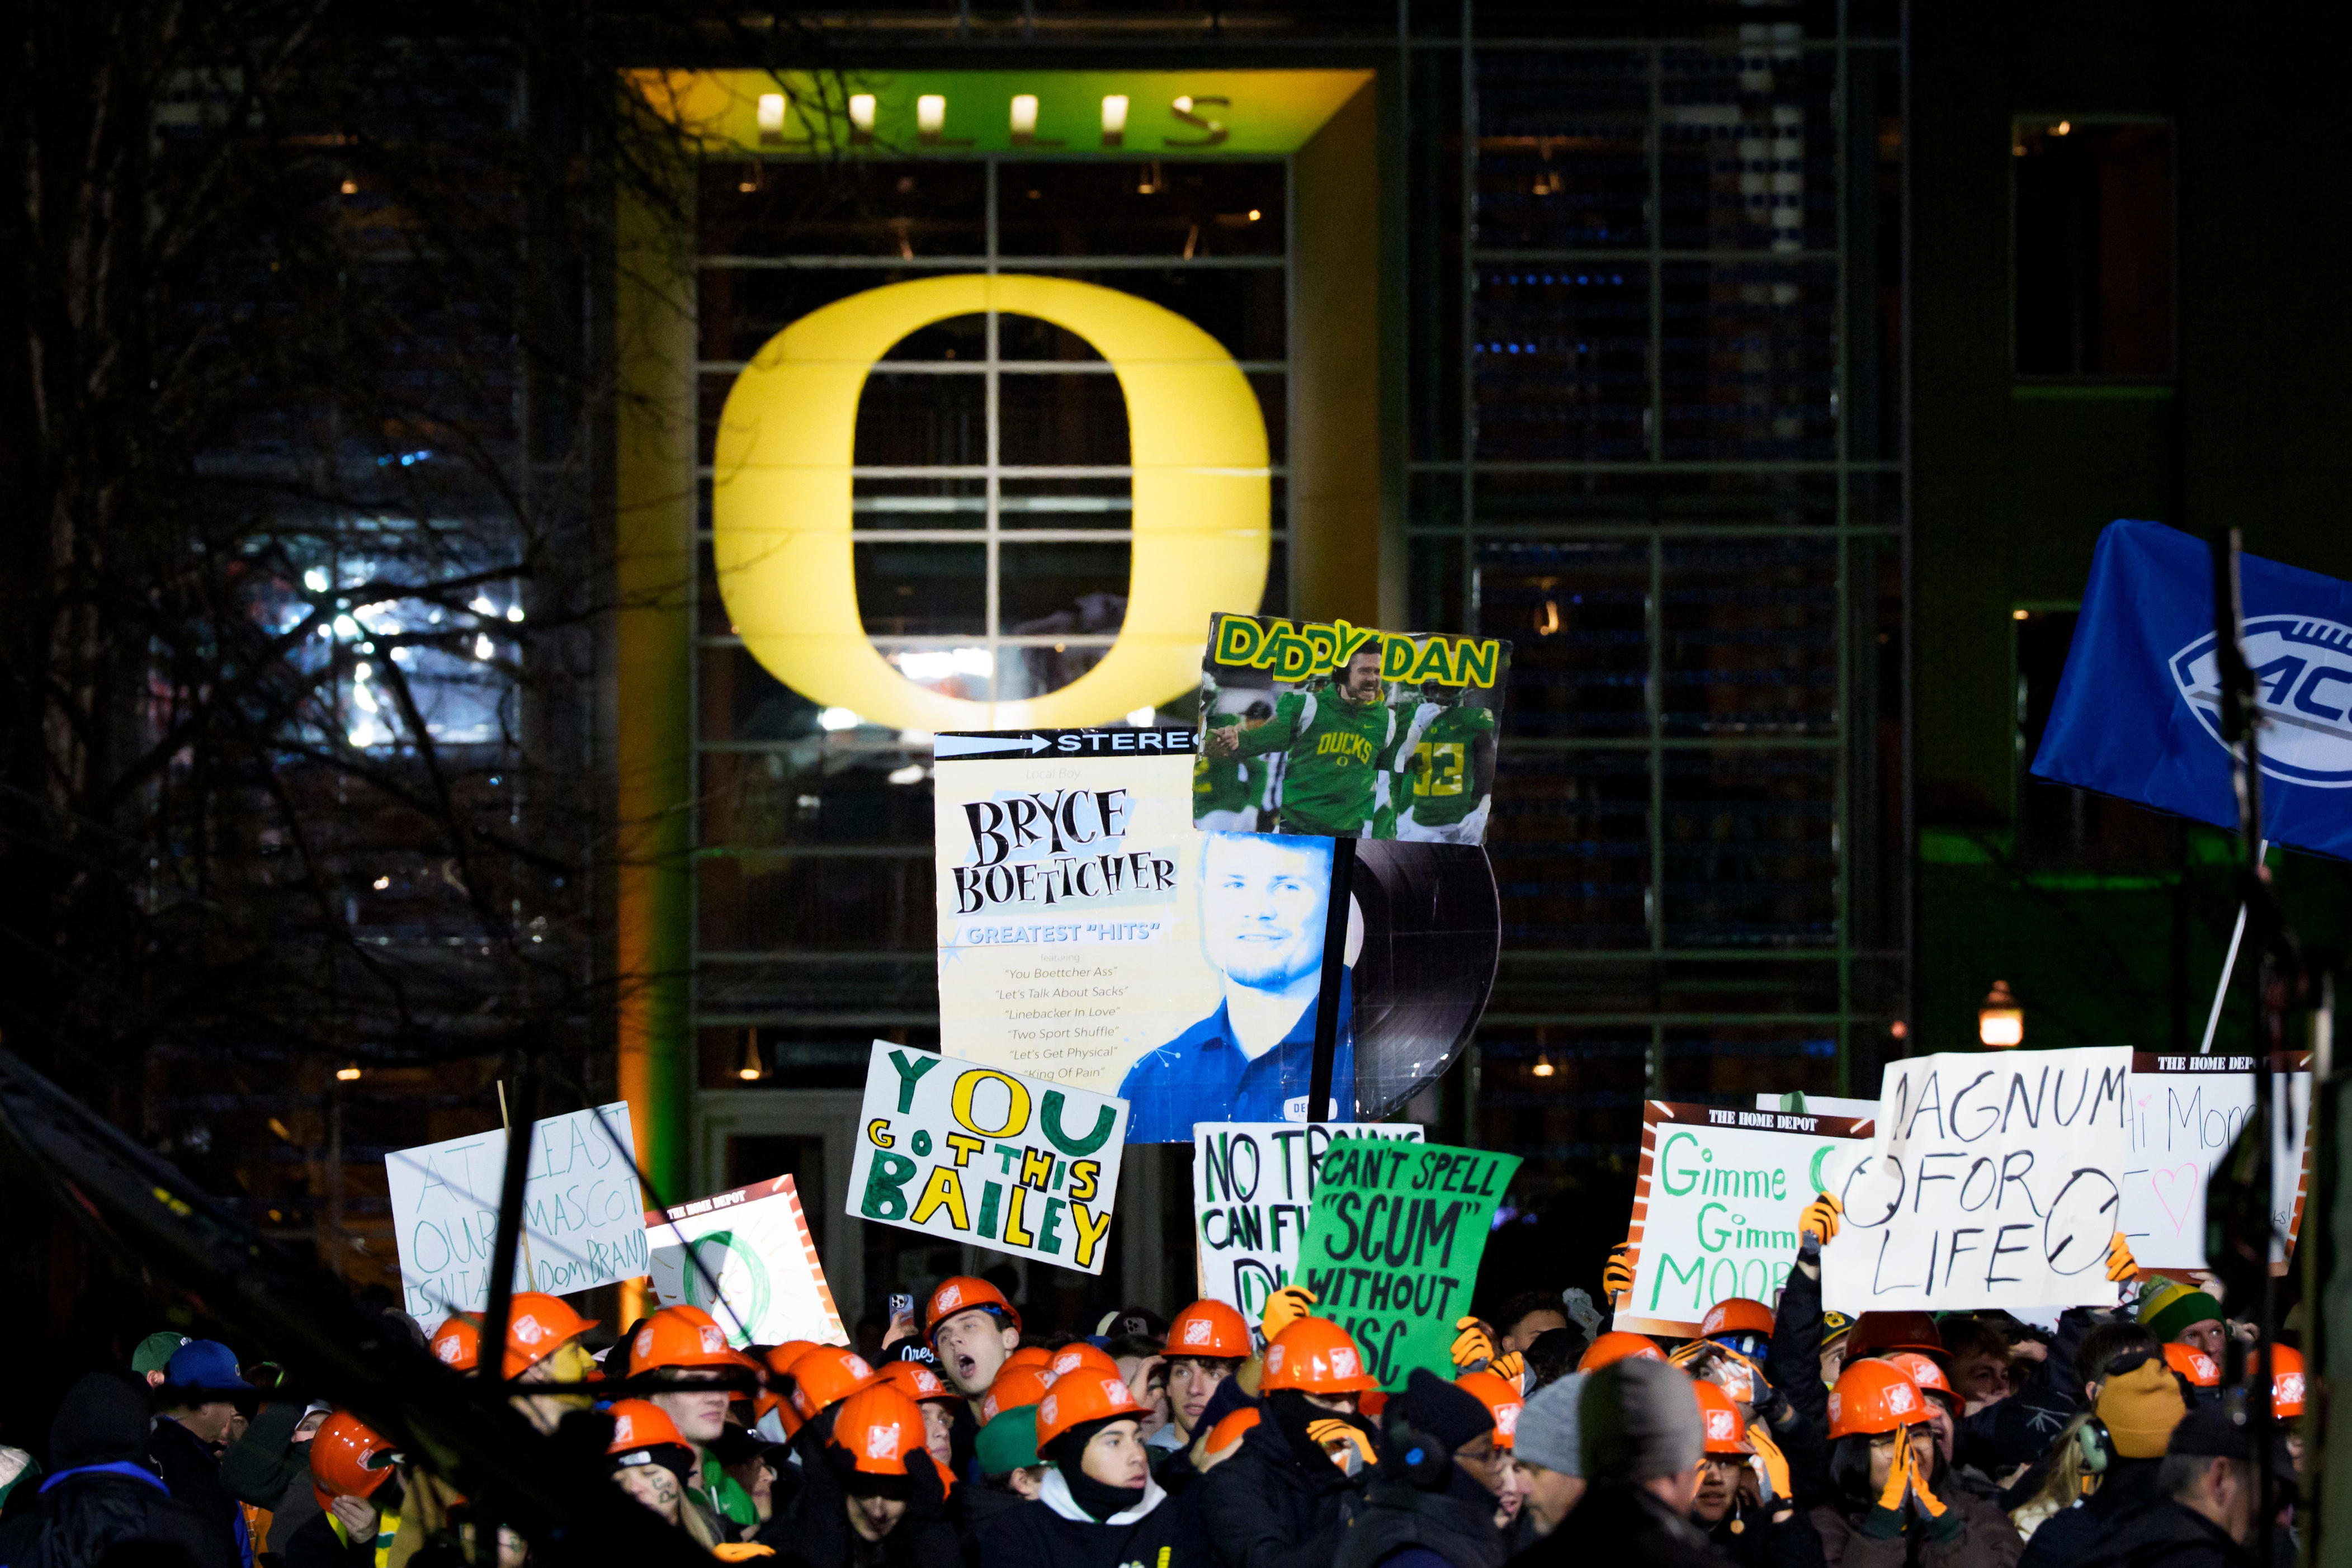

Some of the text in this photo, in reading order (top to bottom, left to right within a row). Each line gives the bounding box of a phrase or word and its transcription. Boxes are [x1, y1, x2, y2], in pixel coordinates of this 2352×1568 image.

[712, 273, 1271, 730] O
[1380, 637, 1499, 688] DAN
[2213, 654, 2352, 724] AC
[1057, 732, 1198, 751] STERE
[1317, 733, 1372, 765] DUCKS
[1026, 768, 1081, 781] Local Boy
[962, 788, 1127, 868] BRYCE
[952, 852, 1177, 914] BOETTCHER
[967, 923, 1160, 943] GREATEST "HITS"
[1041, 953, 1079, 963] featuring
[995, 986, 1128, 1000] "Let's Talk About Sacks"
[1005, 966, 1117, 979] "You Boettcher Ass"
[1005, 1007, 1120, 1020] "Linebacker In Love"
[1008, 1027, 1118, 1041] "Two Sport Shuffle"
[1010, 1047, 1117, 1060] "Let's Get Physical"
[1057, 1068, 1073, 1078] Of
[1076, 1068, 1104, 1077] Pain"
[2158, 1056, 2260, 1070] THE HOME DEP
[888, 1050, 1117, 1156] YOU
[1709, 1109, 1818, 1131] THE HOME DEPOT
[417, 1143, 485, 1213] AT
[867, 1118, 1101, 1201] GOT THIS
[1206, 1131, 1260, 1202] NO
[1321, 1147, 1409, 1189] CAN'T
[1413, 1151, 1499, 1196] SPELL
[1662, 1132, 1787, 1201] Gimme
[1914, 1150, 2045, 1217] FOR
[713, 1190, 746, 1207] DEPOT
[861, 1149, 1111, 1268] BAILEY
[414, 1176, 640, 1273] OUR MASCOT
[1201, 1205, 1263, 1250] CAN
[1323, 1192, 1481, 1268] "SCUM"
[1698, 1202, 1796, 1253] Gimm
[587, 1229, 648, 1284] BRAND
[1649, 1253, 1793, 1311] MOOR
[1873, 1224, 2034, 1296] LIFE
[1308, 1268, 1459, 1320] WITHOUT
